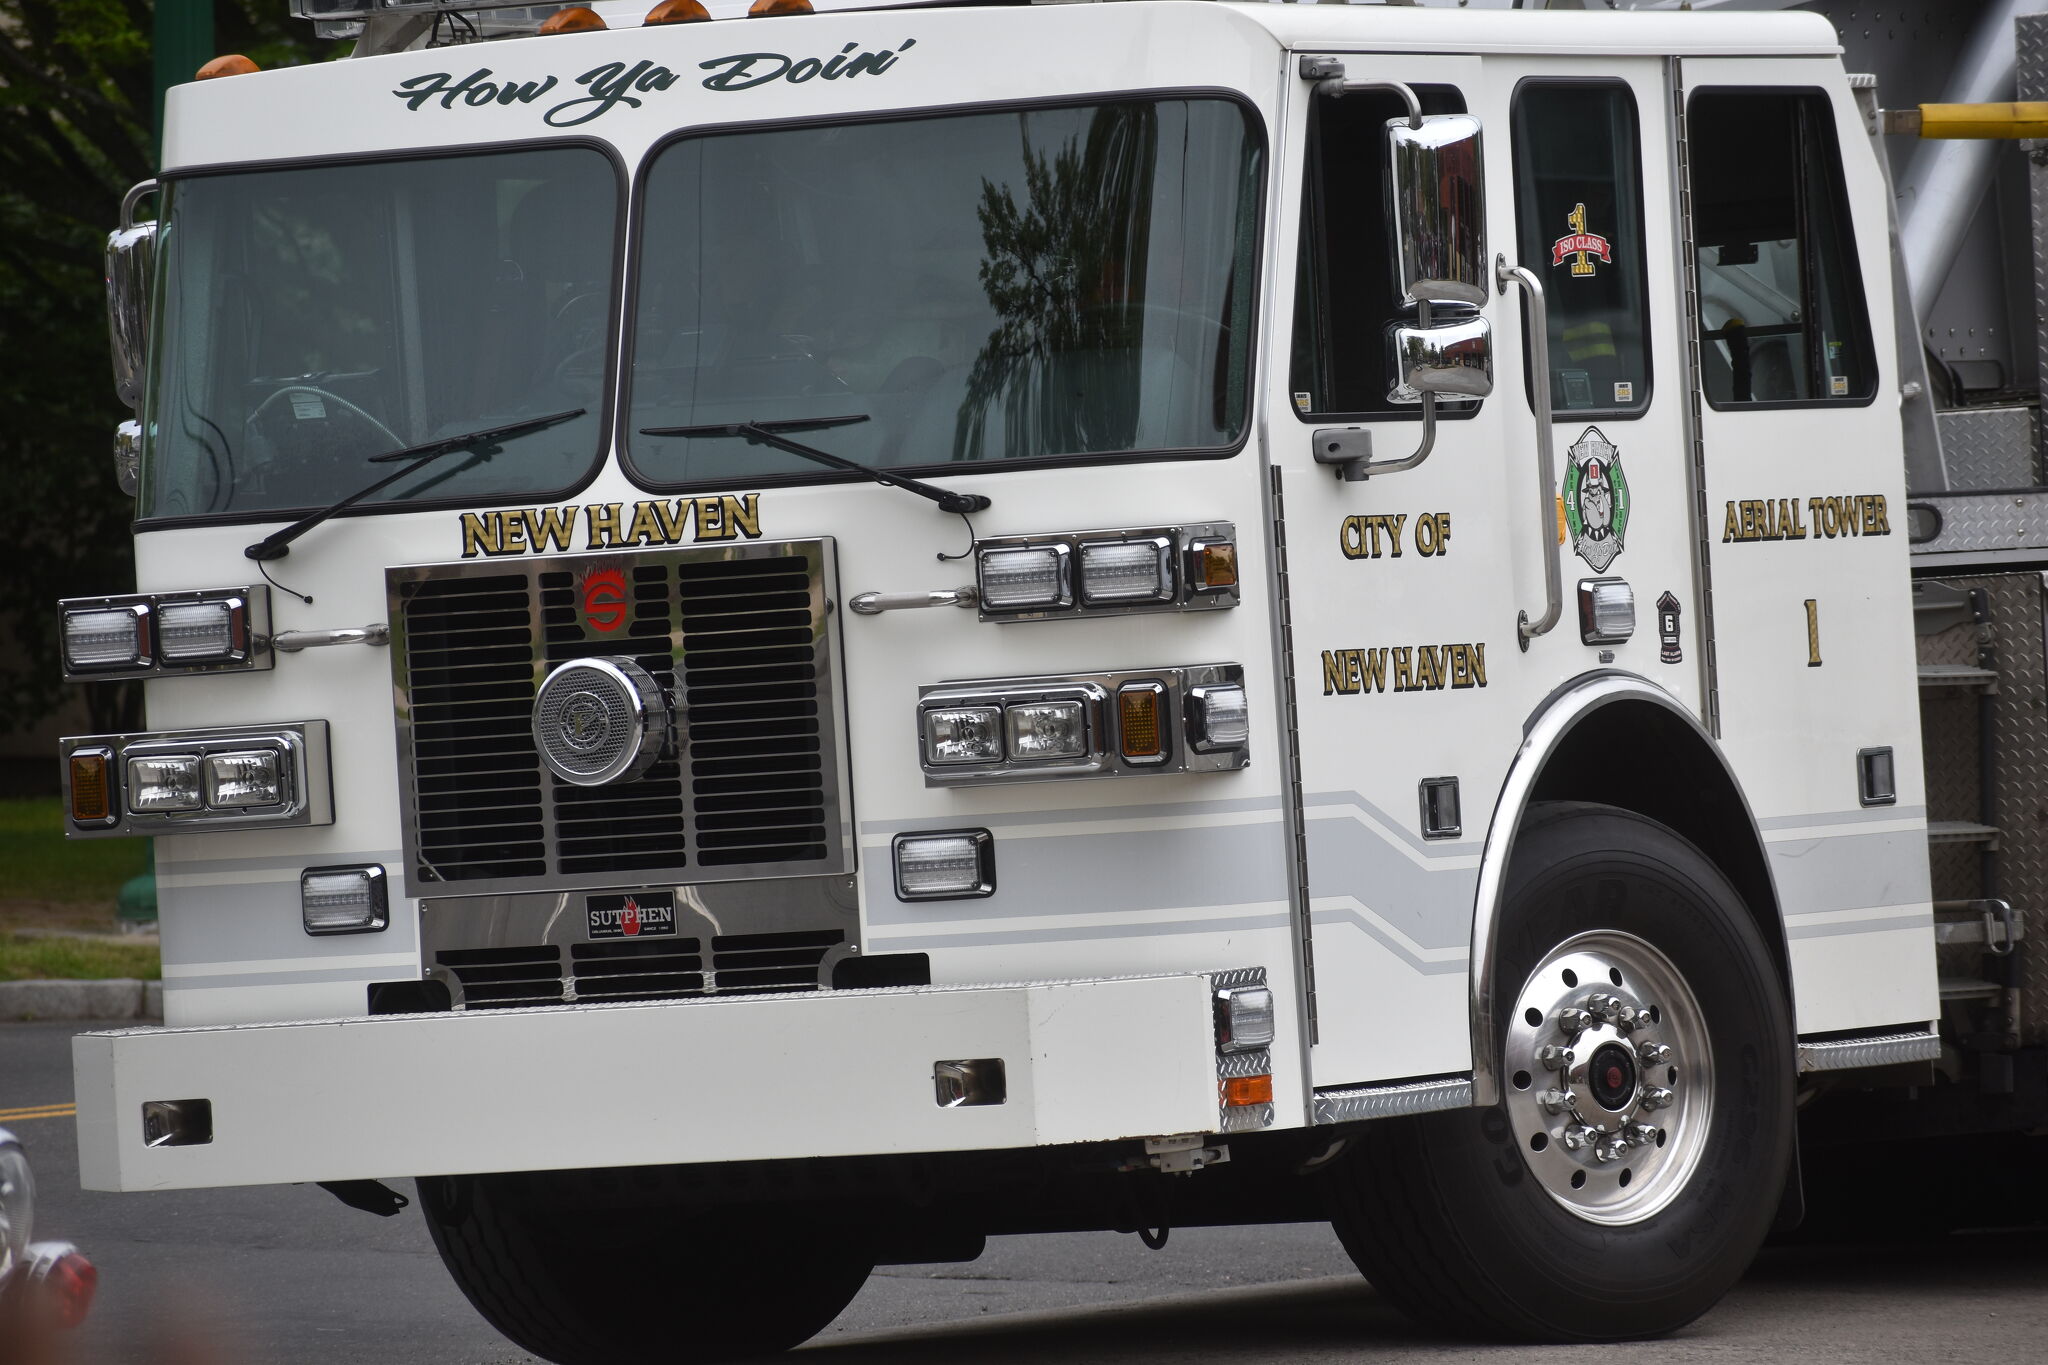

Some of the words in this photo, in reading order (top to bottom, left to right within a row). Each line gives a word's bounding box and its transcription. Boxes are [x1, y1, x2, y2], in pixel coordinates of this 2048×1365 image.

[391, 67, 559, 112] How
[542, 59, 682, 128] Ya
[698, 37, 917, 92] Doin'
[1559, 237, 1575, 254] ISO
[1575, 236, 1603, 252] CLASS
[1566, 490, 1576, 511] 4
[1617, 488, 1625, 510] 1
[458, 505, 580, 558] NEW
[584, 492, 763, 550] HAVEN
[1721, 498, 1807, 543] AERIAL
[1808, 494, 1891, 539] TOWER
[1339, 513, 1408, 561] CITY
[1414, 512, 1451, 558] OF
[1664, 614, 1674, 632] 6
[1320, 647, 1390, 696] NEW
[1390, 643, 1488, 693] HAVEN
[590, 906, 672, 927] SUTPHEN
